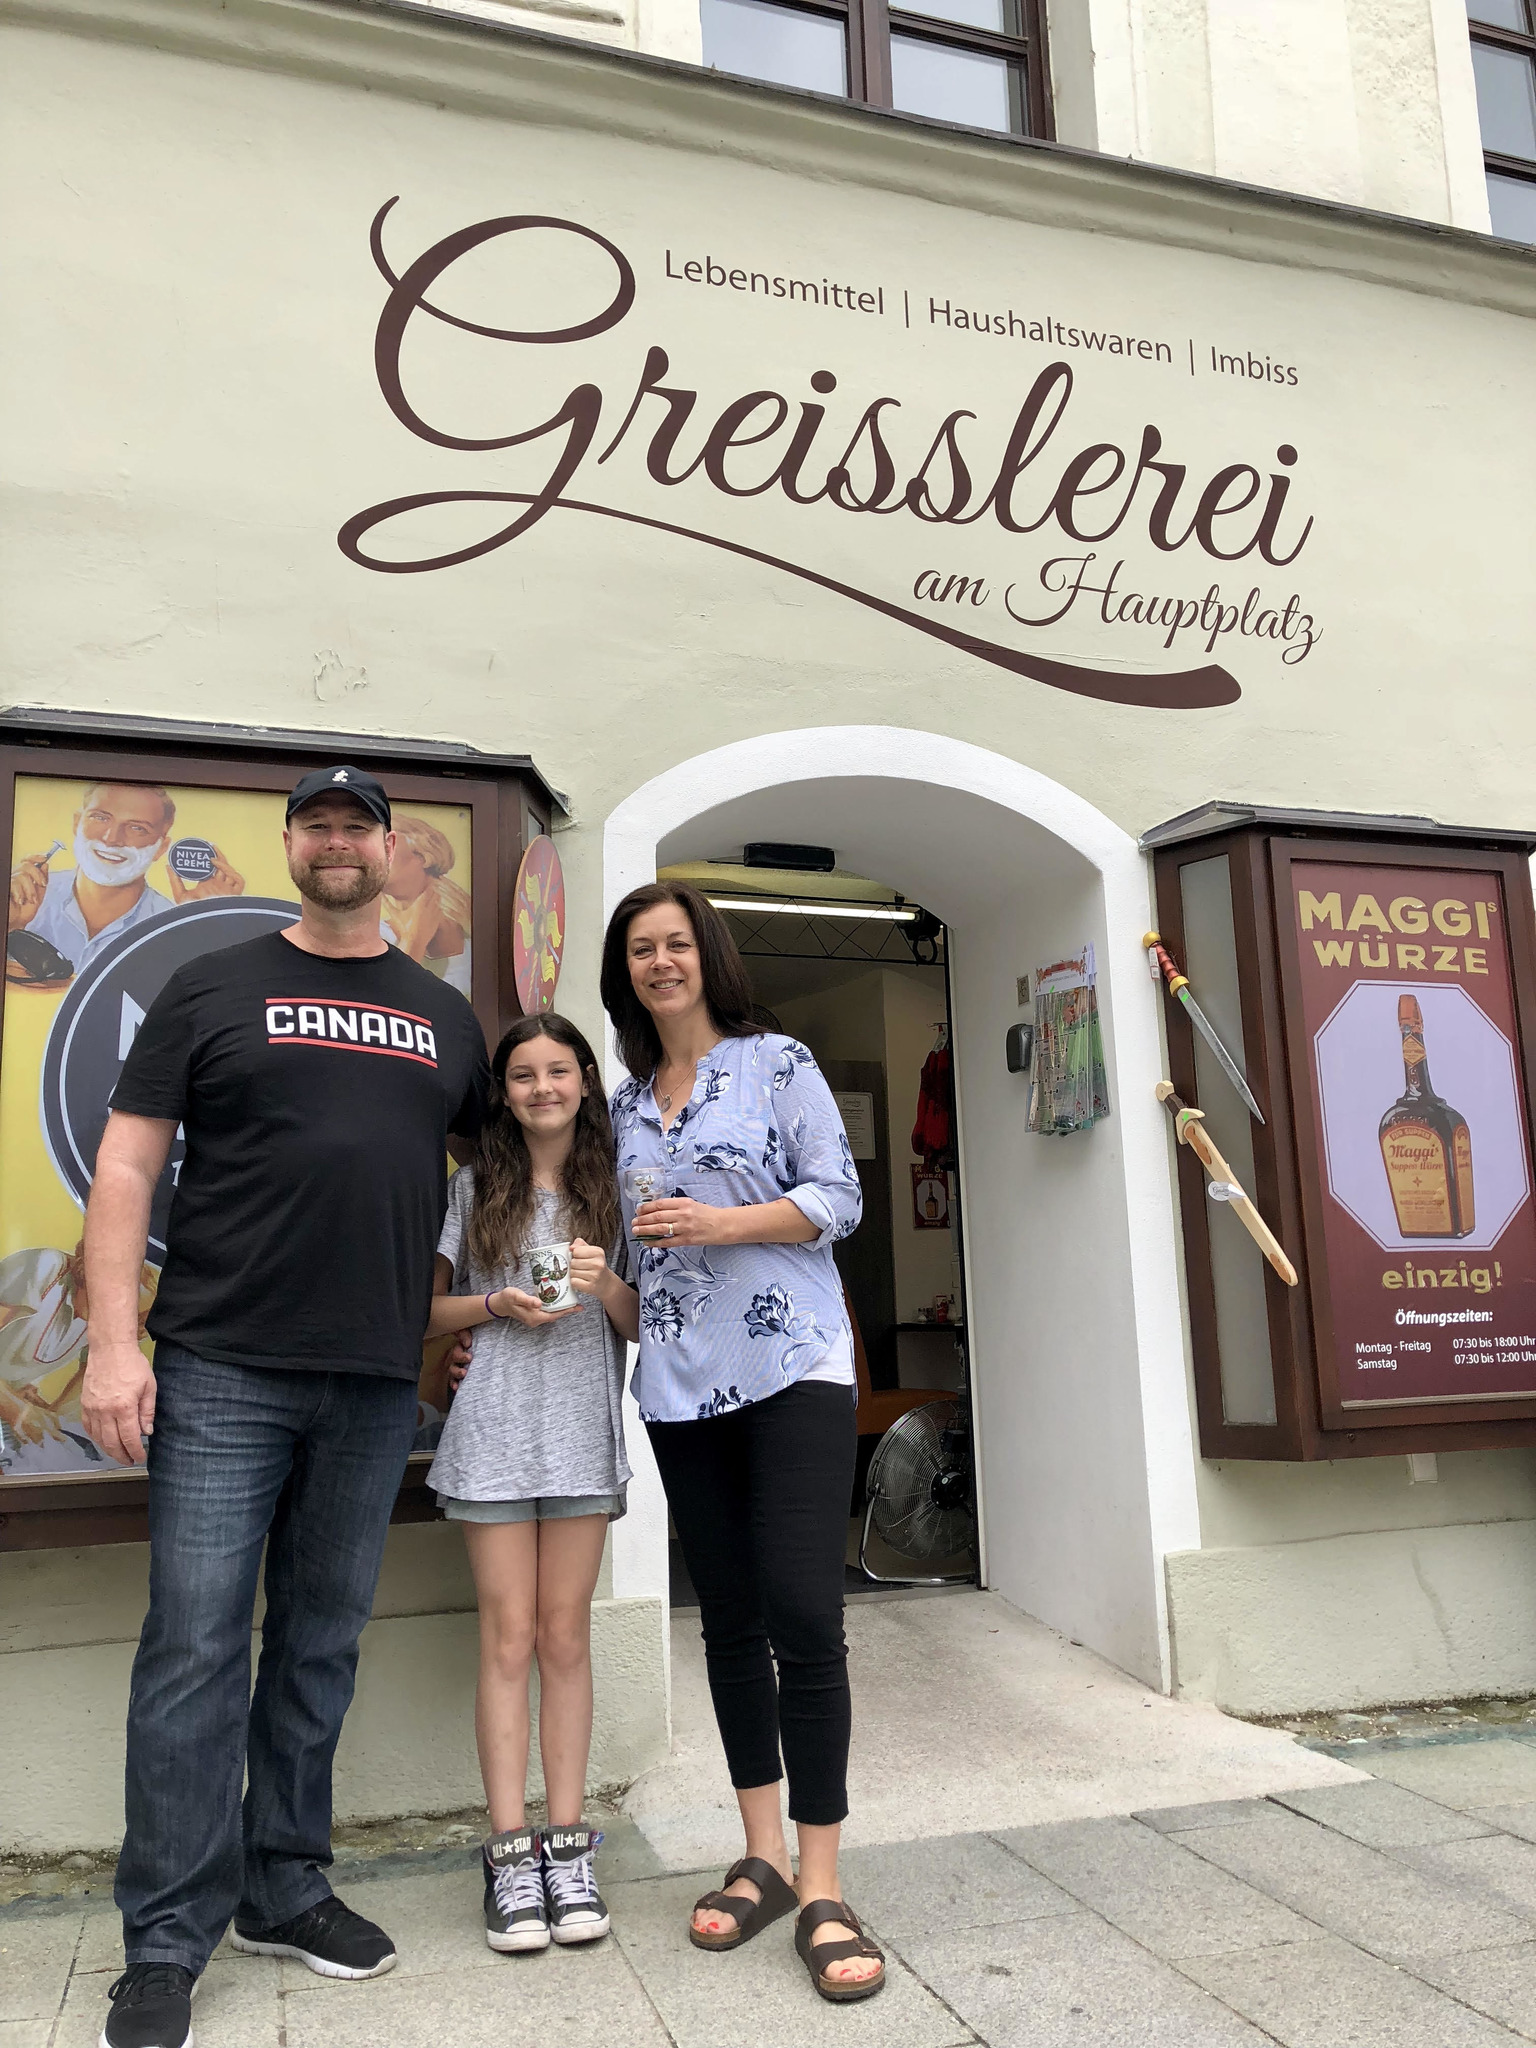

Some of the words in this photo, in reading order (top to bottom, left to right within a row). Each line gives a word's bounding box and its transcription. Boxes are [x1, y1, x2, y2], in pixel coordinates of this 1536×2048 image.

[665, 249, 885, 316] Lebensmittel
[929, 297, 1173, 364] Haushaltswaren
[1211, 346, 1299, 387] Imbiss
[338, 196, 1314, 574] Greisslerei
[913, 569, 991, 607] am
[1004, 552, 1323, 665] Hauptplatz
[176, 851, 210, 860] NIVEA
[176, 858, 211, 869] CREME
[1312, 933, 1489, 975] WÜRZE
[265, 1005, 438, 1060] CANADA
[1382, 1260, 1502, 1294] einzig!
[1396, 1309, 1493, 1326] Öffnungszeiten:
[1355, 1342, 1393, 1354] Montag
[1399, 1340, 1432, 1353] Freitag
[1452, 1337, 1478, 1349] 07:30
[1479, 1336, 1493, 1348] bis
[1494, 1335, 1518, 1347] 18:00
[1519, 1335, 1536, 1346] Uhr
[1357, 1358, 1398, 1370] Samstag
[1454, 1353, 1480, 1365] 07:30
[1481, 1352, 1495, 1364] bis
[1496, 1351, 1520, 1363] 12:00
[492, 1844, 504, 1859] ALL
[513, 1836, 532, 1853] STAR
[552, 1833, 564, 1849] ALL
[574, 1832, 589, 1847] STAR
